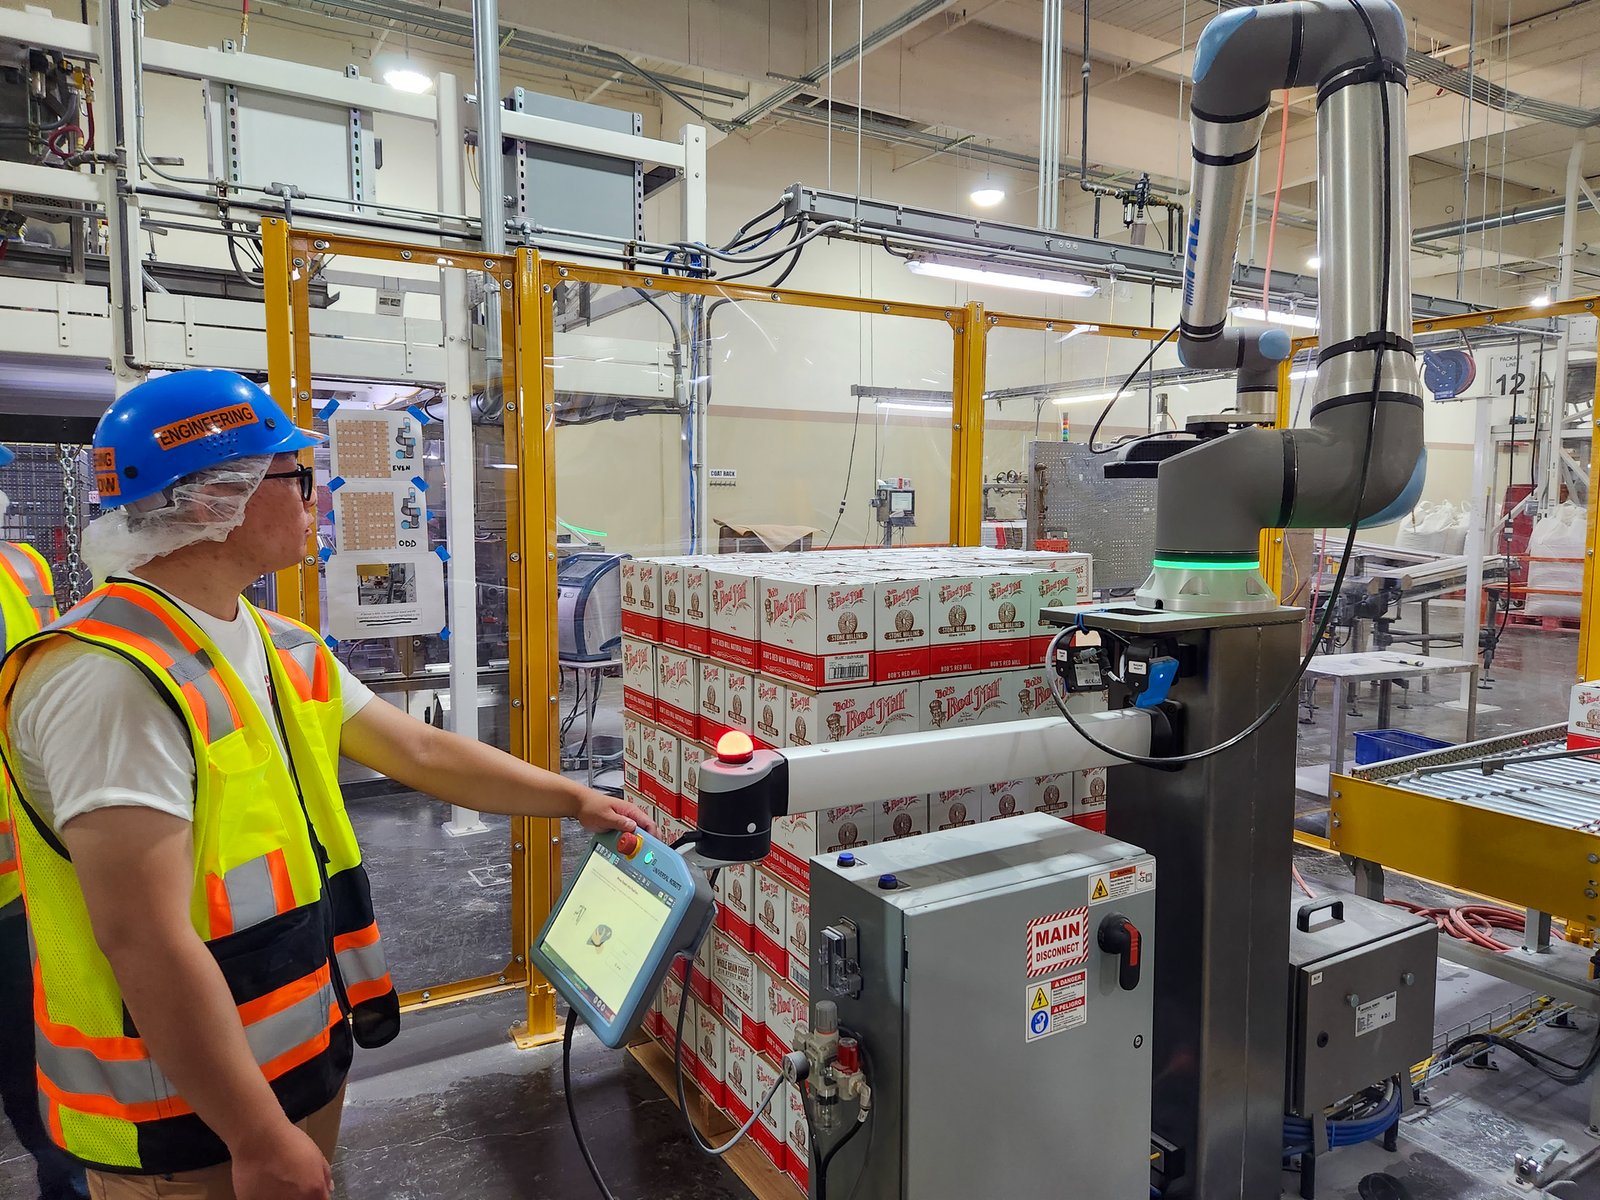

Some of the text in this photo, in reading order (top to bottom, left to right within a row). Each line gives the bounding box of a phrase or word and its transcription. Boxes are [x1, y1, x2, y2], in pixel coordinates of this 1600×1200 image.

[1496, 373, 1526, 396] 12
[160, 407, 253, 446] ENGINEERING
[392, 464, 410, 472] EVEN
[398, 540, 416, 548] ODD
[1024, 676, 1042, 688] Bob's
[935, 686, 955, 698] Bob's
[833, 698, 855, 712] Bob's
[946, 679, 1000, 721] Red Mill
[846, 690, 905, 736] Red Mill
[1036, 921, 1080, 947] MAIN
[1036, 942, 1079, 962] DISCONNECT
[1060, 975, 1081, 986] DANGER
[1060, 999, 1082, 1011] PELIGRO
